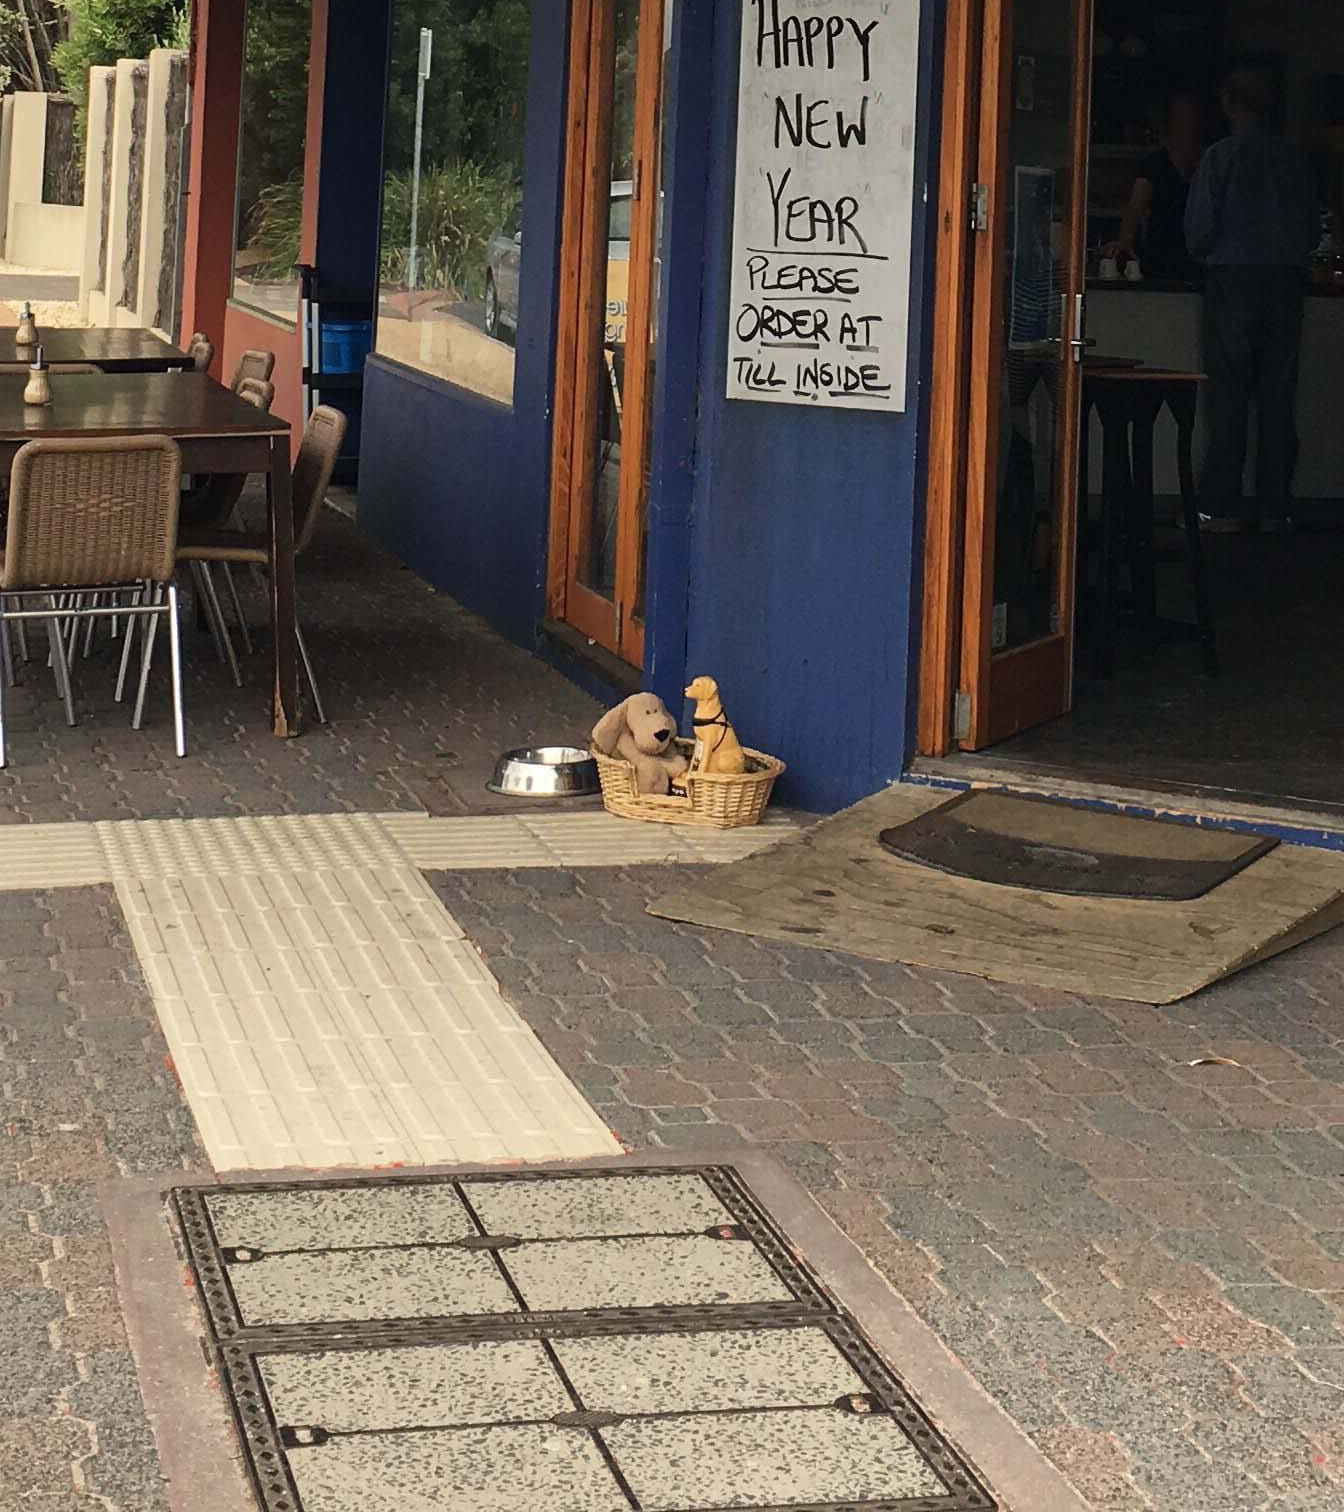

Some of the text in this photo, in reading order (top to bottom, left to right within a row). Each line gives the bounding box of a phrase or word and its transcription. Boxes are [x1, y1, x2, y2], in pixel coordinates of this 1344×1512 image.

[774, 92, 869, 149] NEW
[766, 168, 868, 254] YEAR
[746, 255, 860, 295] PLEASE
[736, 304, 883, 346] ORDER AT
[733, 356, 892, 391] TILL INSIDE
